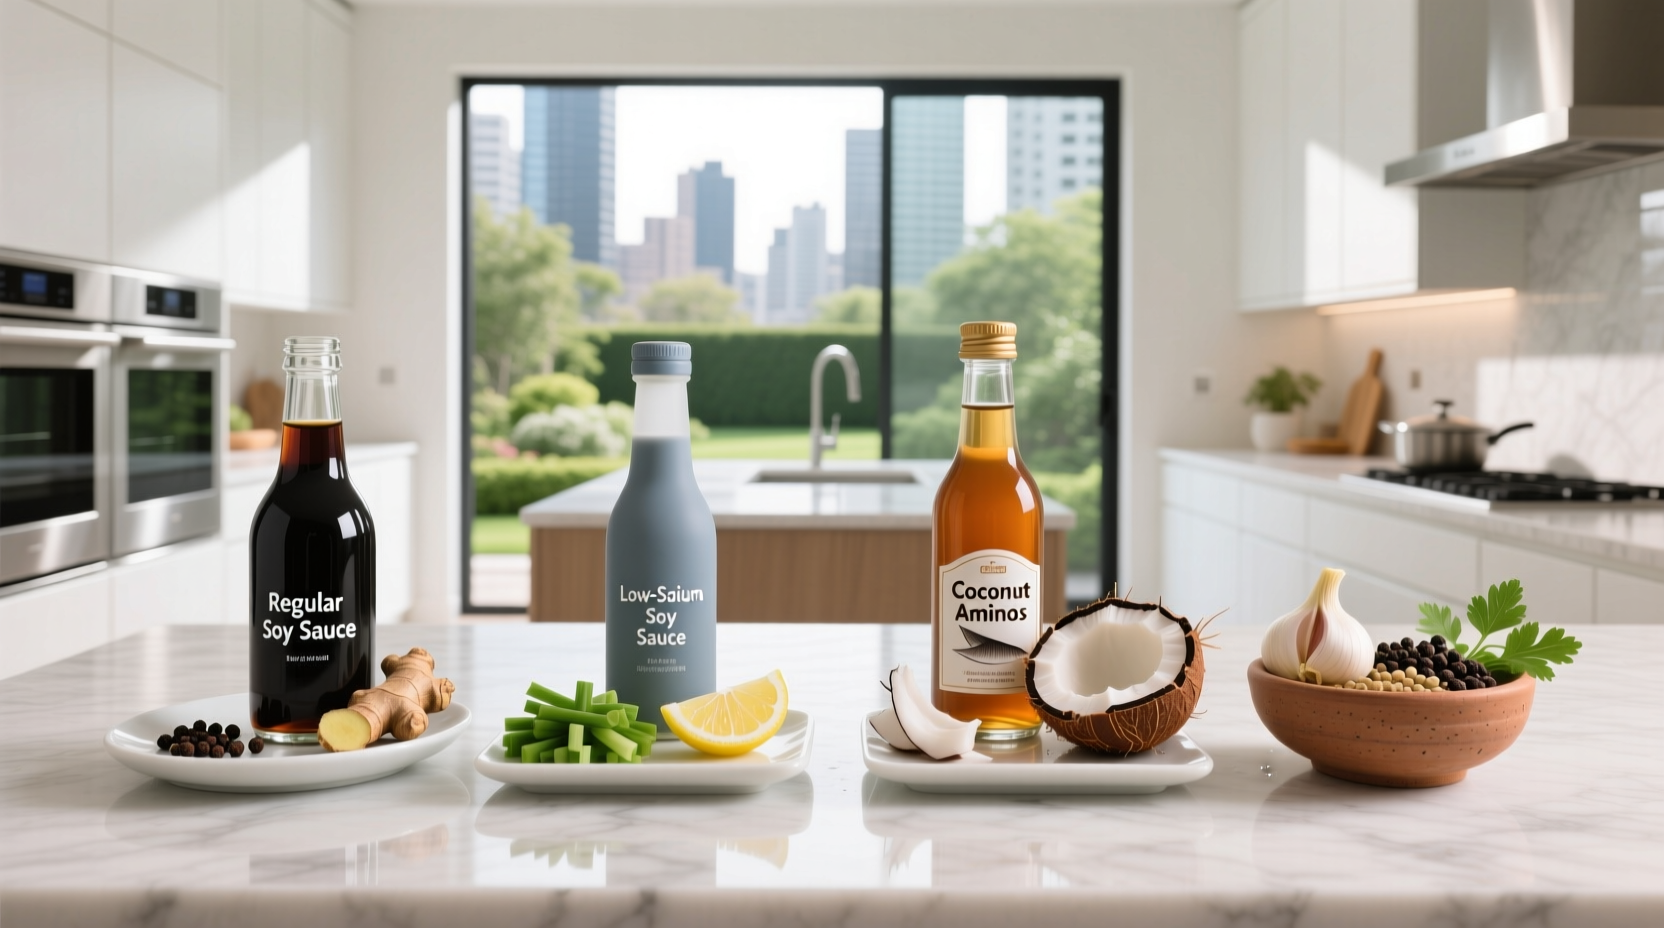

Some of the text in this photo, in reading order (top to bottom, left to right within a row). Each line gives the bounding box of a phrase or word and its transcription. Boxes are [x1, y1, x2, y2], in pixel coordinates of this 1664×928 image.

[951, 580, 1031, 600] Coconut
[268, 591, 344, 619] Regular
[954, 603, 1028, 622] Aminos
[645, 607, 677, 629] Soy
[262, 619, 357, 646] Soy Sauce
[636, 628, 687, 646] Sauce
